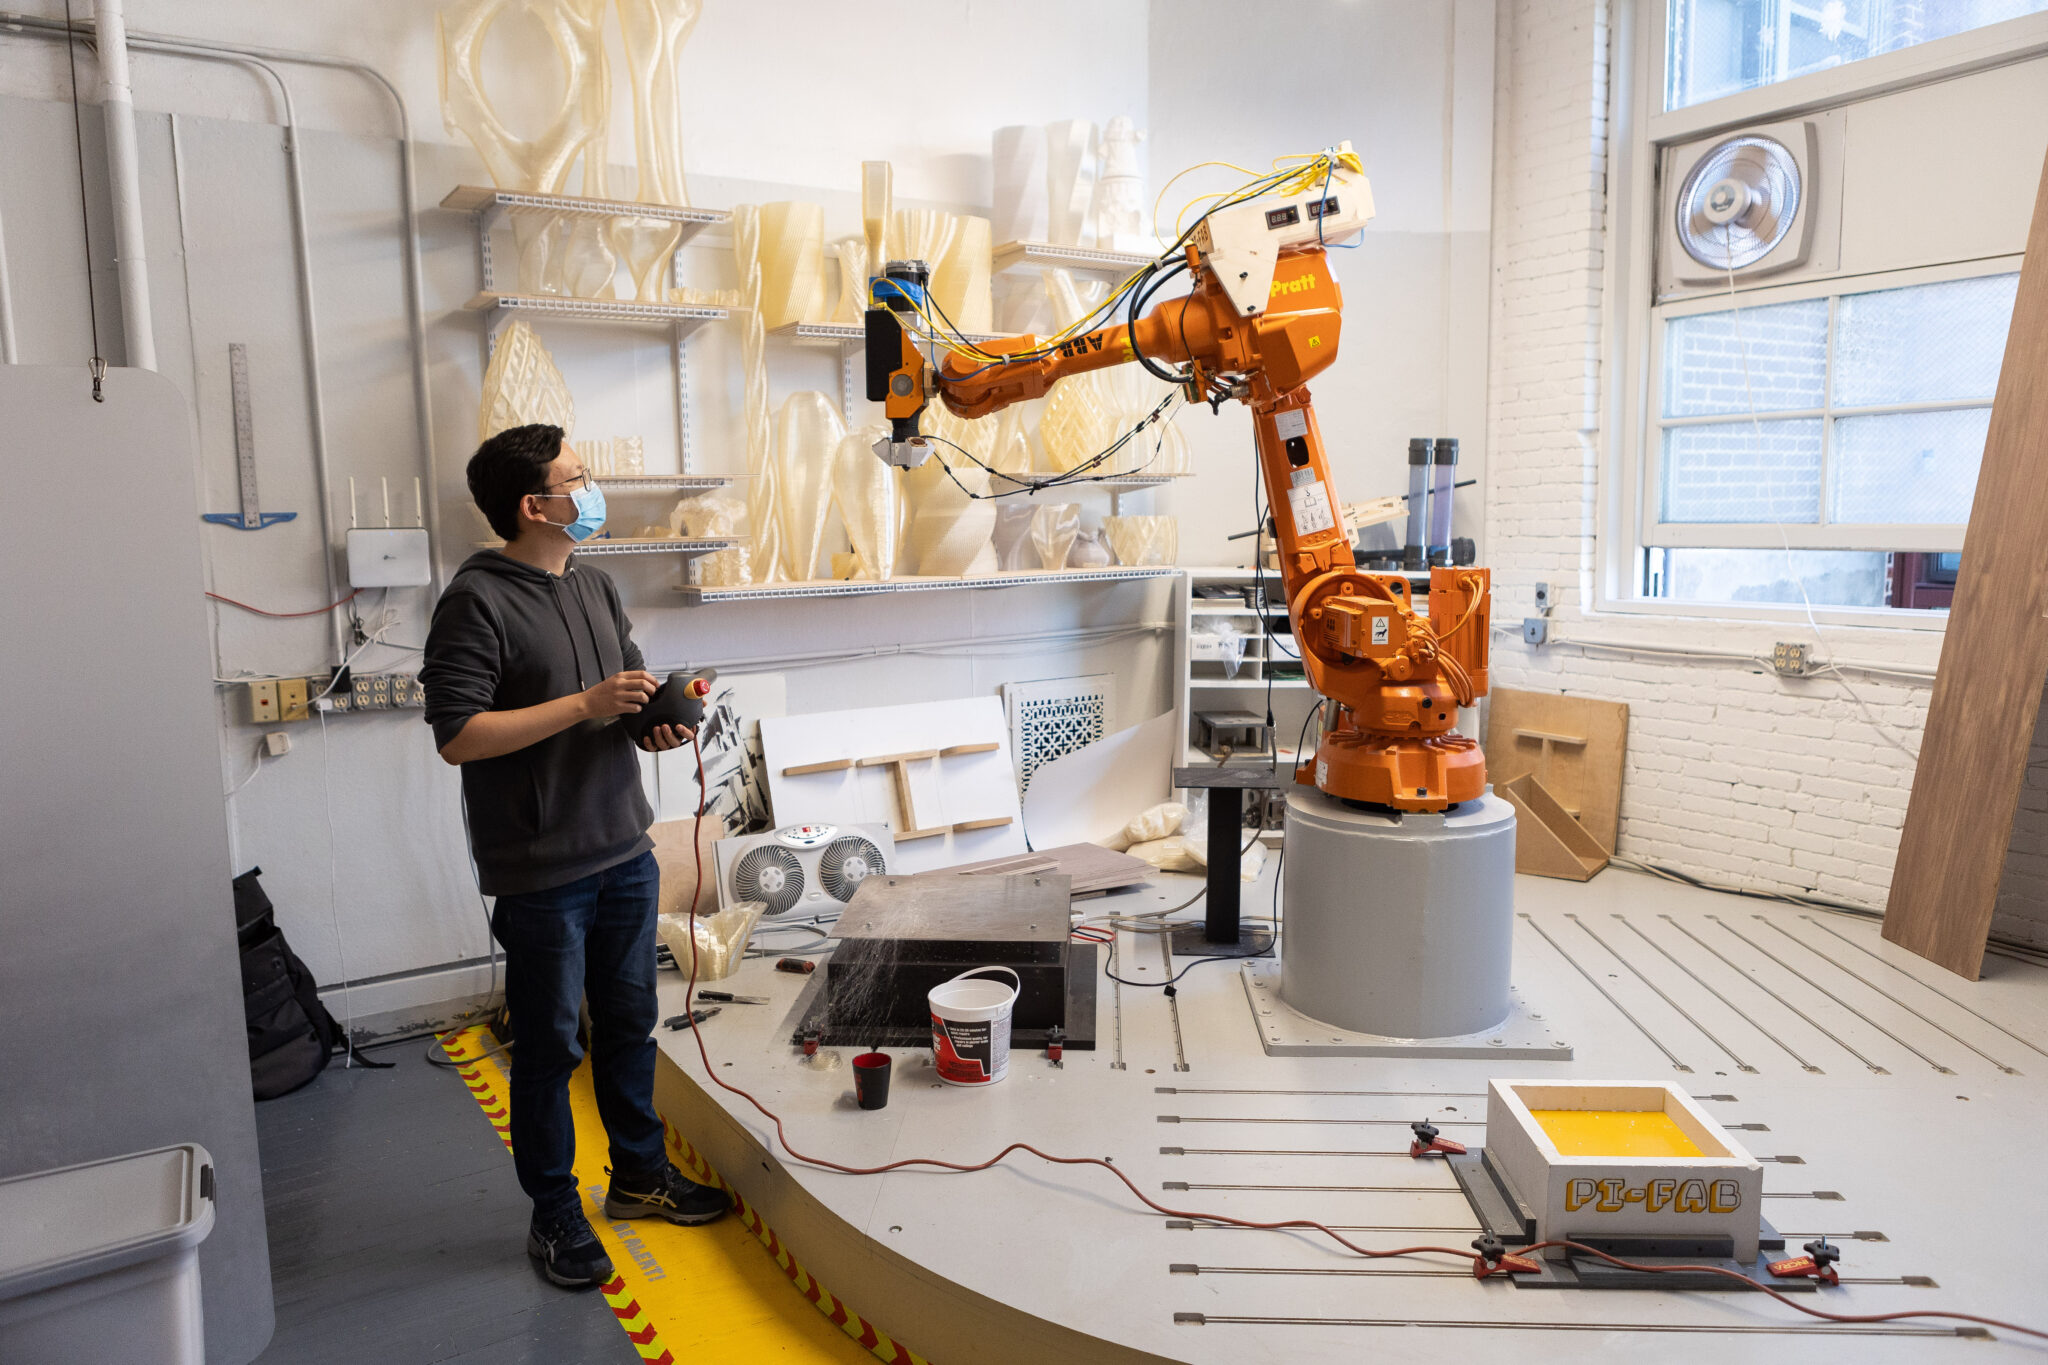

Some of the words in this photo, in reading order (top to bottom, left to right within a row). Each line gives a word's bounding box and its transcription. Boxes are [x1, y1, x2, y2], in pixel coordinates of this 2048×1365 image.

[1270, 273, 1316, 298] Pratt
[1060, 333, 1103, 358] ABB
[1565, 1178, 1742, 1214] PI-FAB
[612, 1222, 637, 1239] BE
[623, 1238, 668, 1282] ALERT!
